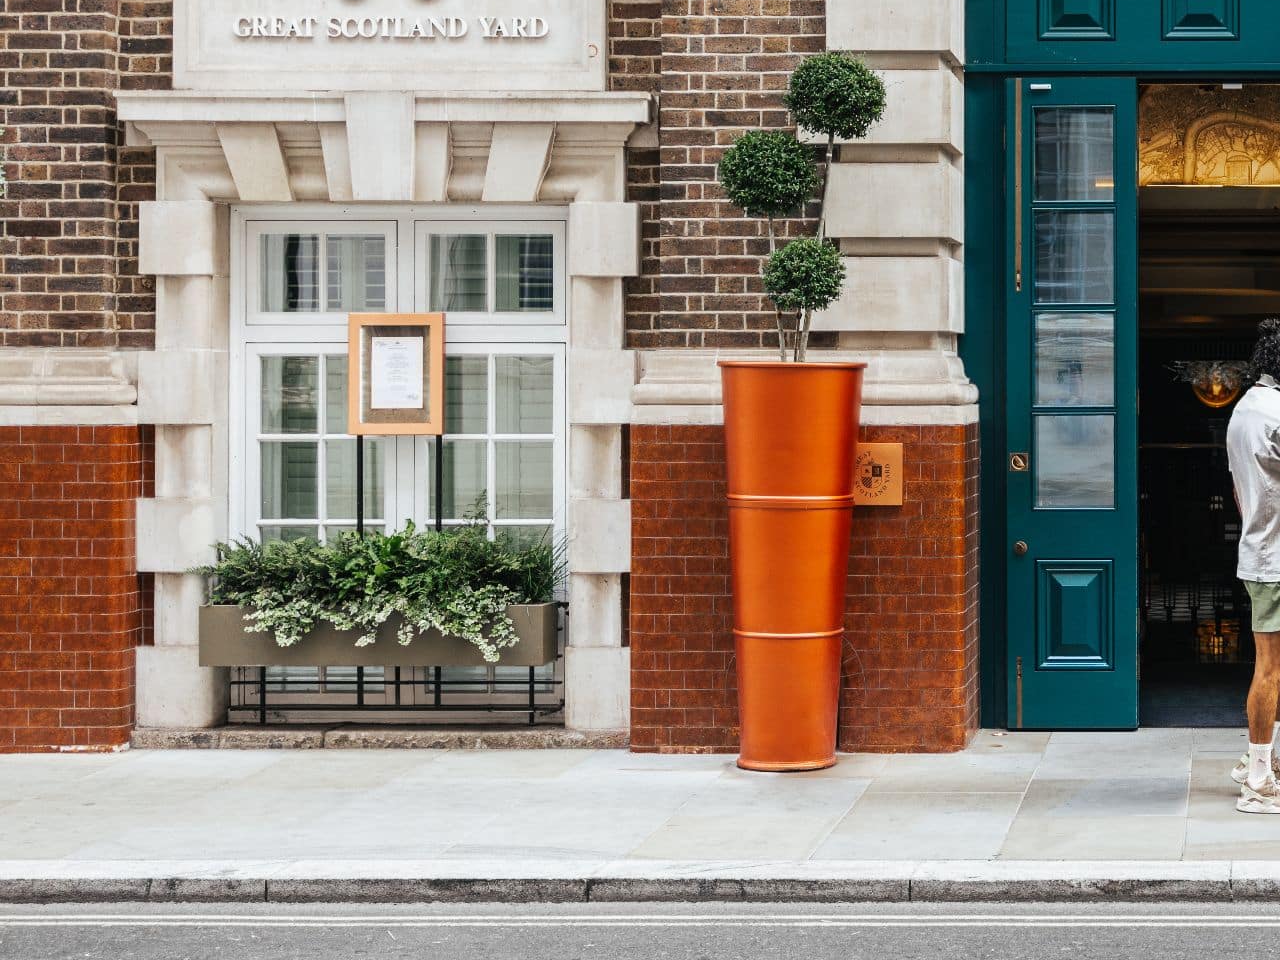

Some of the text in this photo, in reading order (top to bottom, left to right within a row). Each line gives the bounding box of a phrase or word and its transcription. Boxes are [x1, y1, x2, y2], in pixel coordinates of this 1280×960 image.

[232, 15, 550, 39] GREAT SCOTLAND YARD
